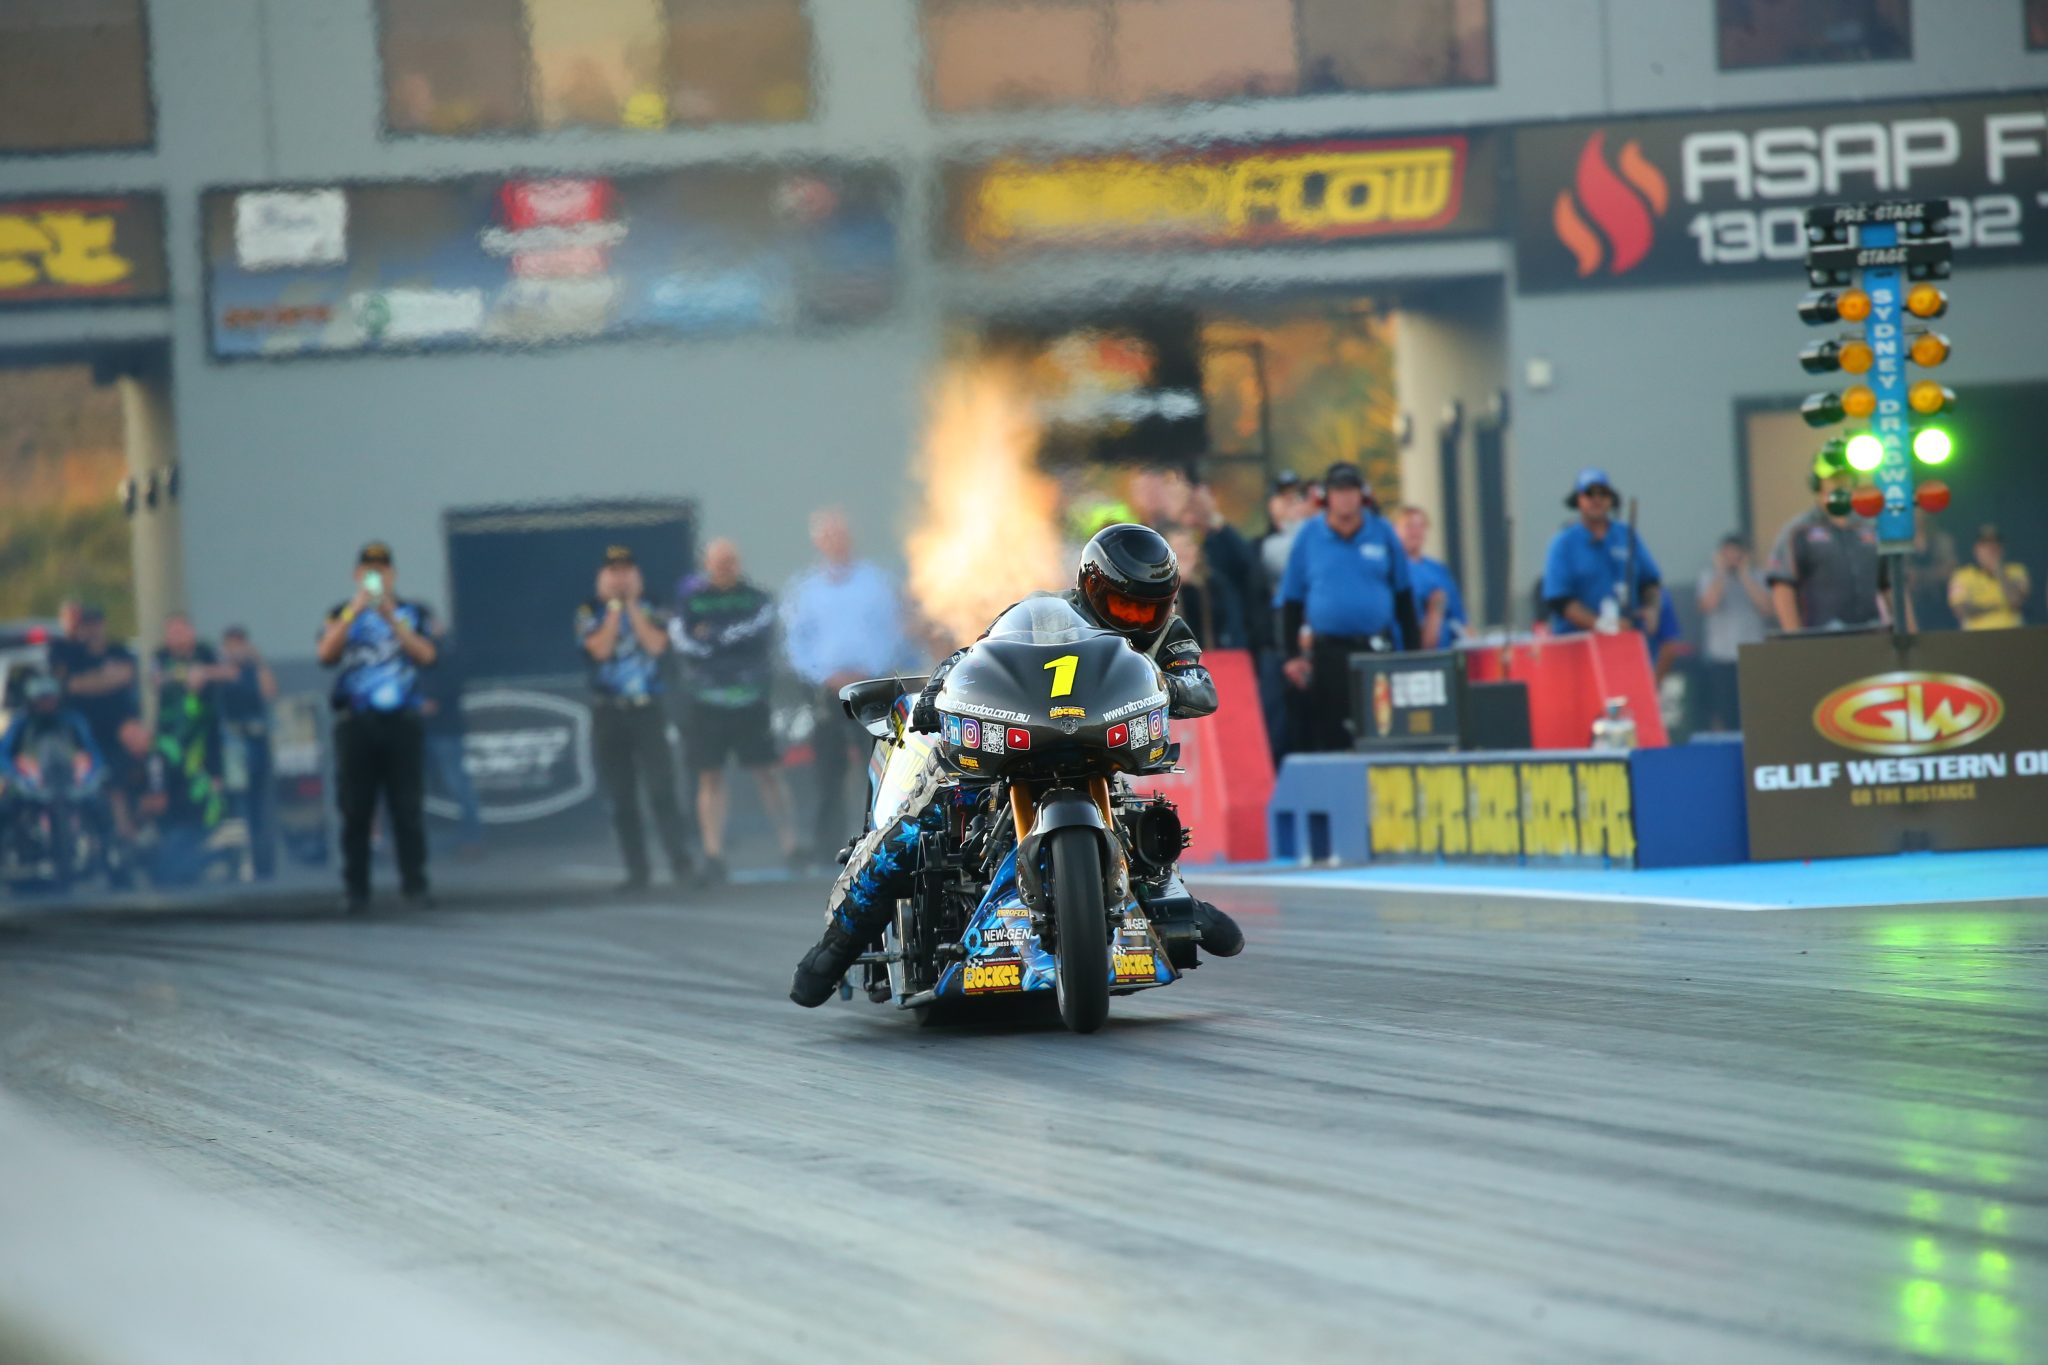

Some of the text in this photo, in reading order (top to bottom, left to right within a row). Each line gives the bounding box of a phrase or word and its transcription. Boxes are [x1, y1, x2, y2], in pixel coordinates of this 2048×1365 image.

[1682, 120, 1961, 204] ASAP
[1857, 247, 1907, 266] STAGE
[1872, 288, 1898, 389] SYDNEY
[1043, 655, 1079, 698] 1
[1754, 762, 1840, 791] GULF
[1847, 753, 2007, 785] WESTERN
[1905, 782, 1977, 803] DISTANCE
[984, 928, 1031, 942] NEW-GEN
